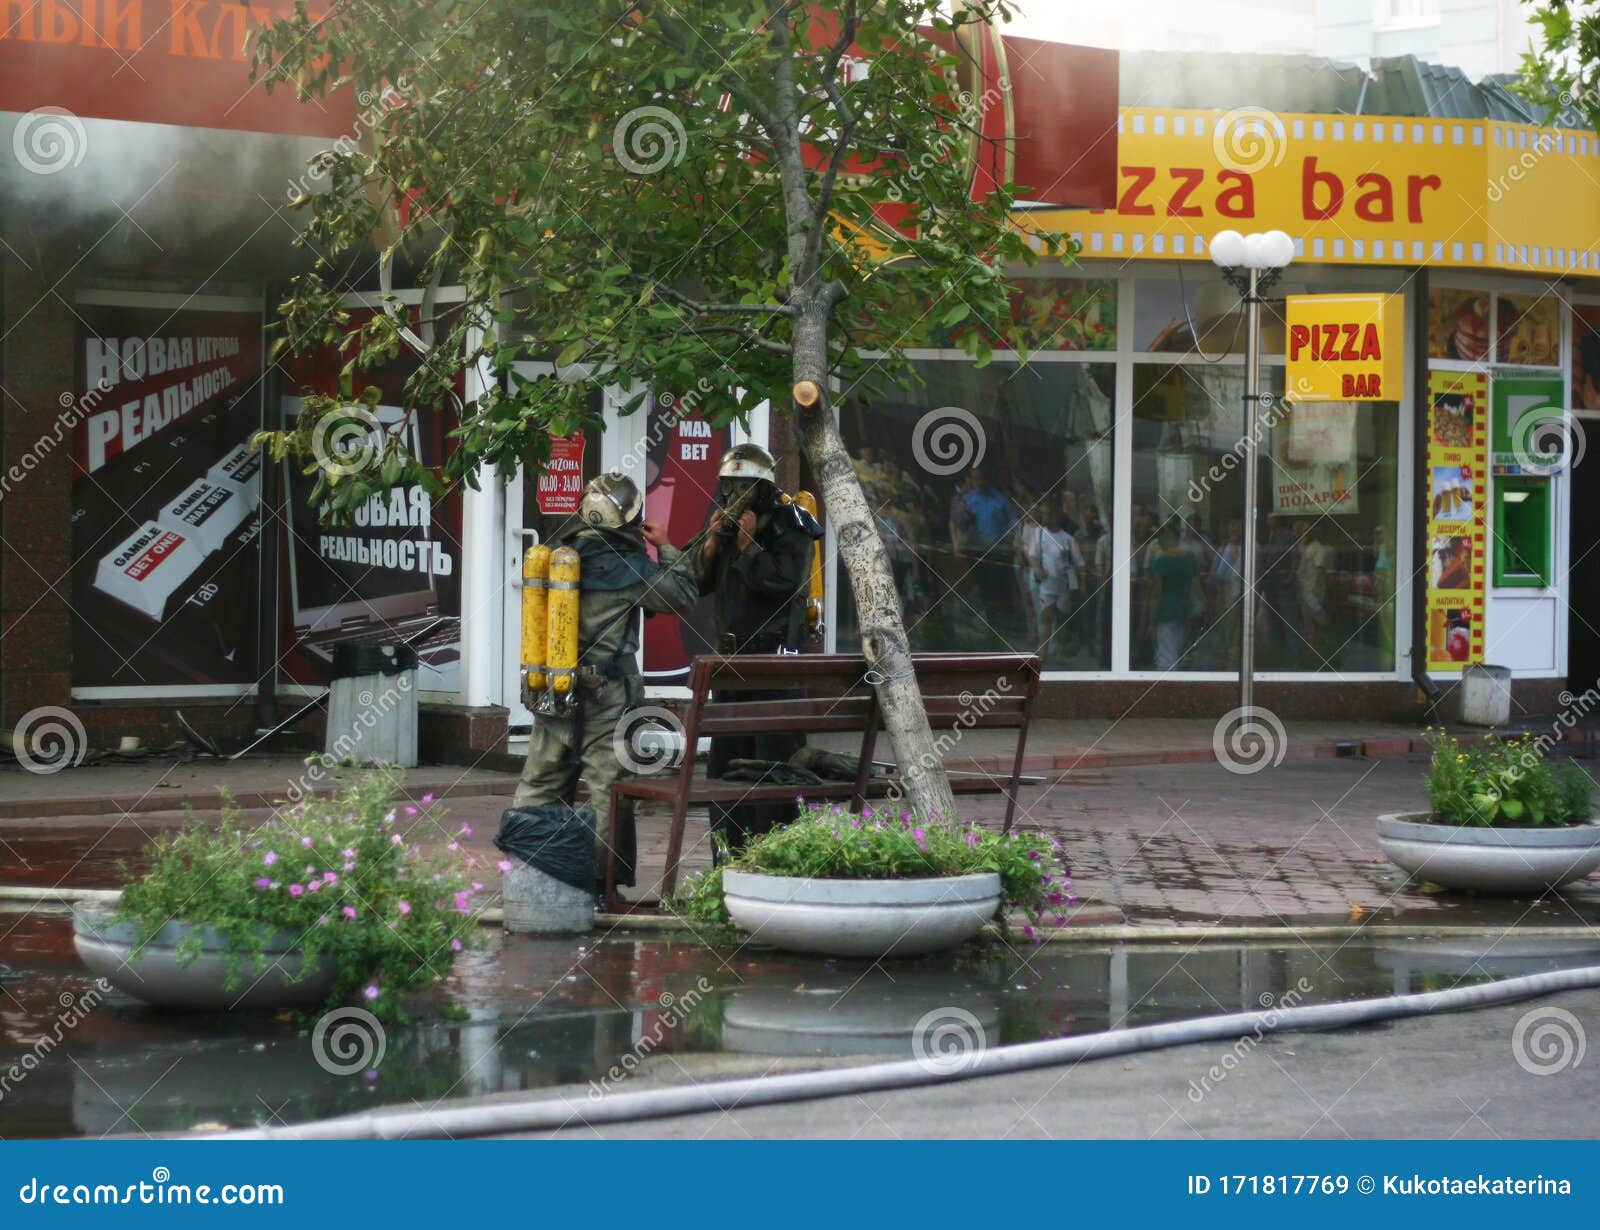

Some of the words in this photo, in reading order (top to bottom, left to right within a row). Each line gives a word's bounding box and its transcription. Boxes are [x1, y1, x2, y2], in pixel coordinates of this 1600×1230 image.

[1089, 166, 1256, 218] zza
[1300, 156, 1442, 224] bar
[1290, 323, 1381, 361] PIZZA
[86, 337, 194, 390] НОВАЯ
[196, 336, 240, 364] ИГРОВАЯ
[1342, 374, 1381, 398] BAR
[679, 420, 712, 438] MAX
[681, 443, 709, 461] BET
[172, 482, 212, 516] GAMBLE
[184, 503, 211, 526] MAX
[206, 487, 230, 505] BET
[113, 526, 162, 567] GAMBLE
[127, 555, 155, 578] BET
[152, 532, 180, 556] ONE
[320, 535, 453, 576] РЕАЛЬНОСТЬ
[187, 582, 218, 608] Tab
